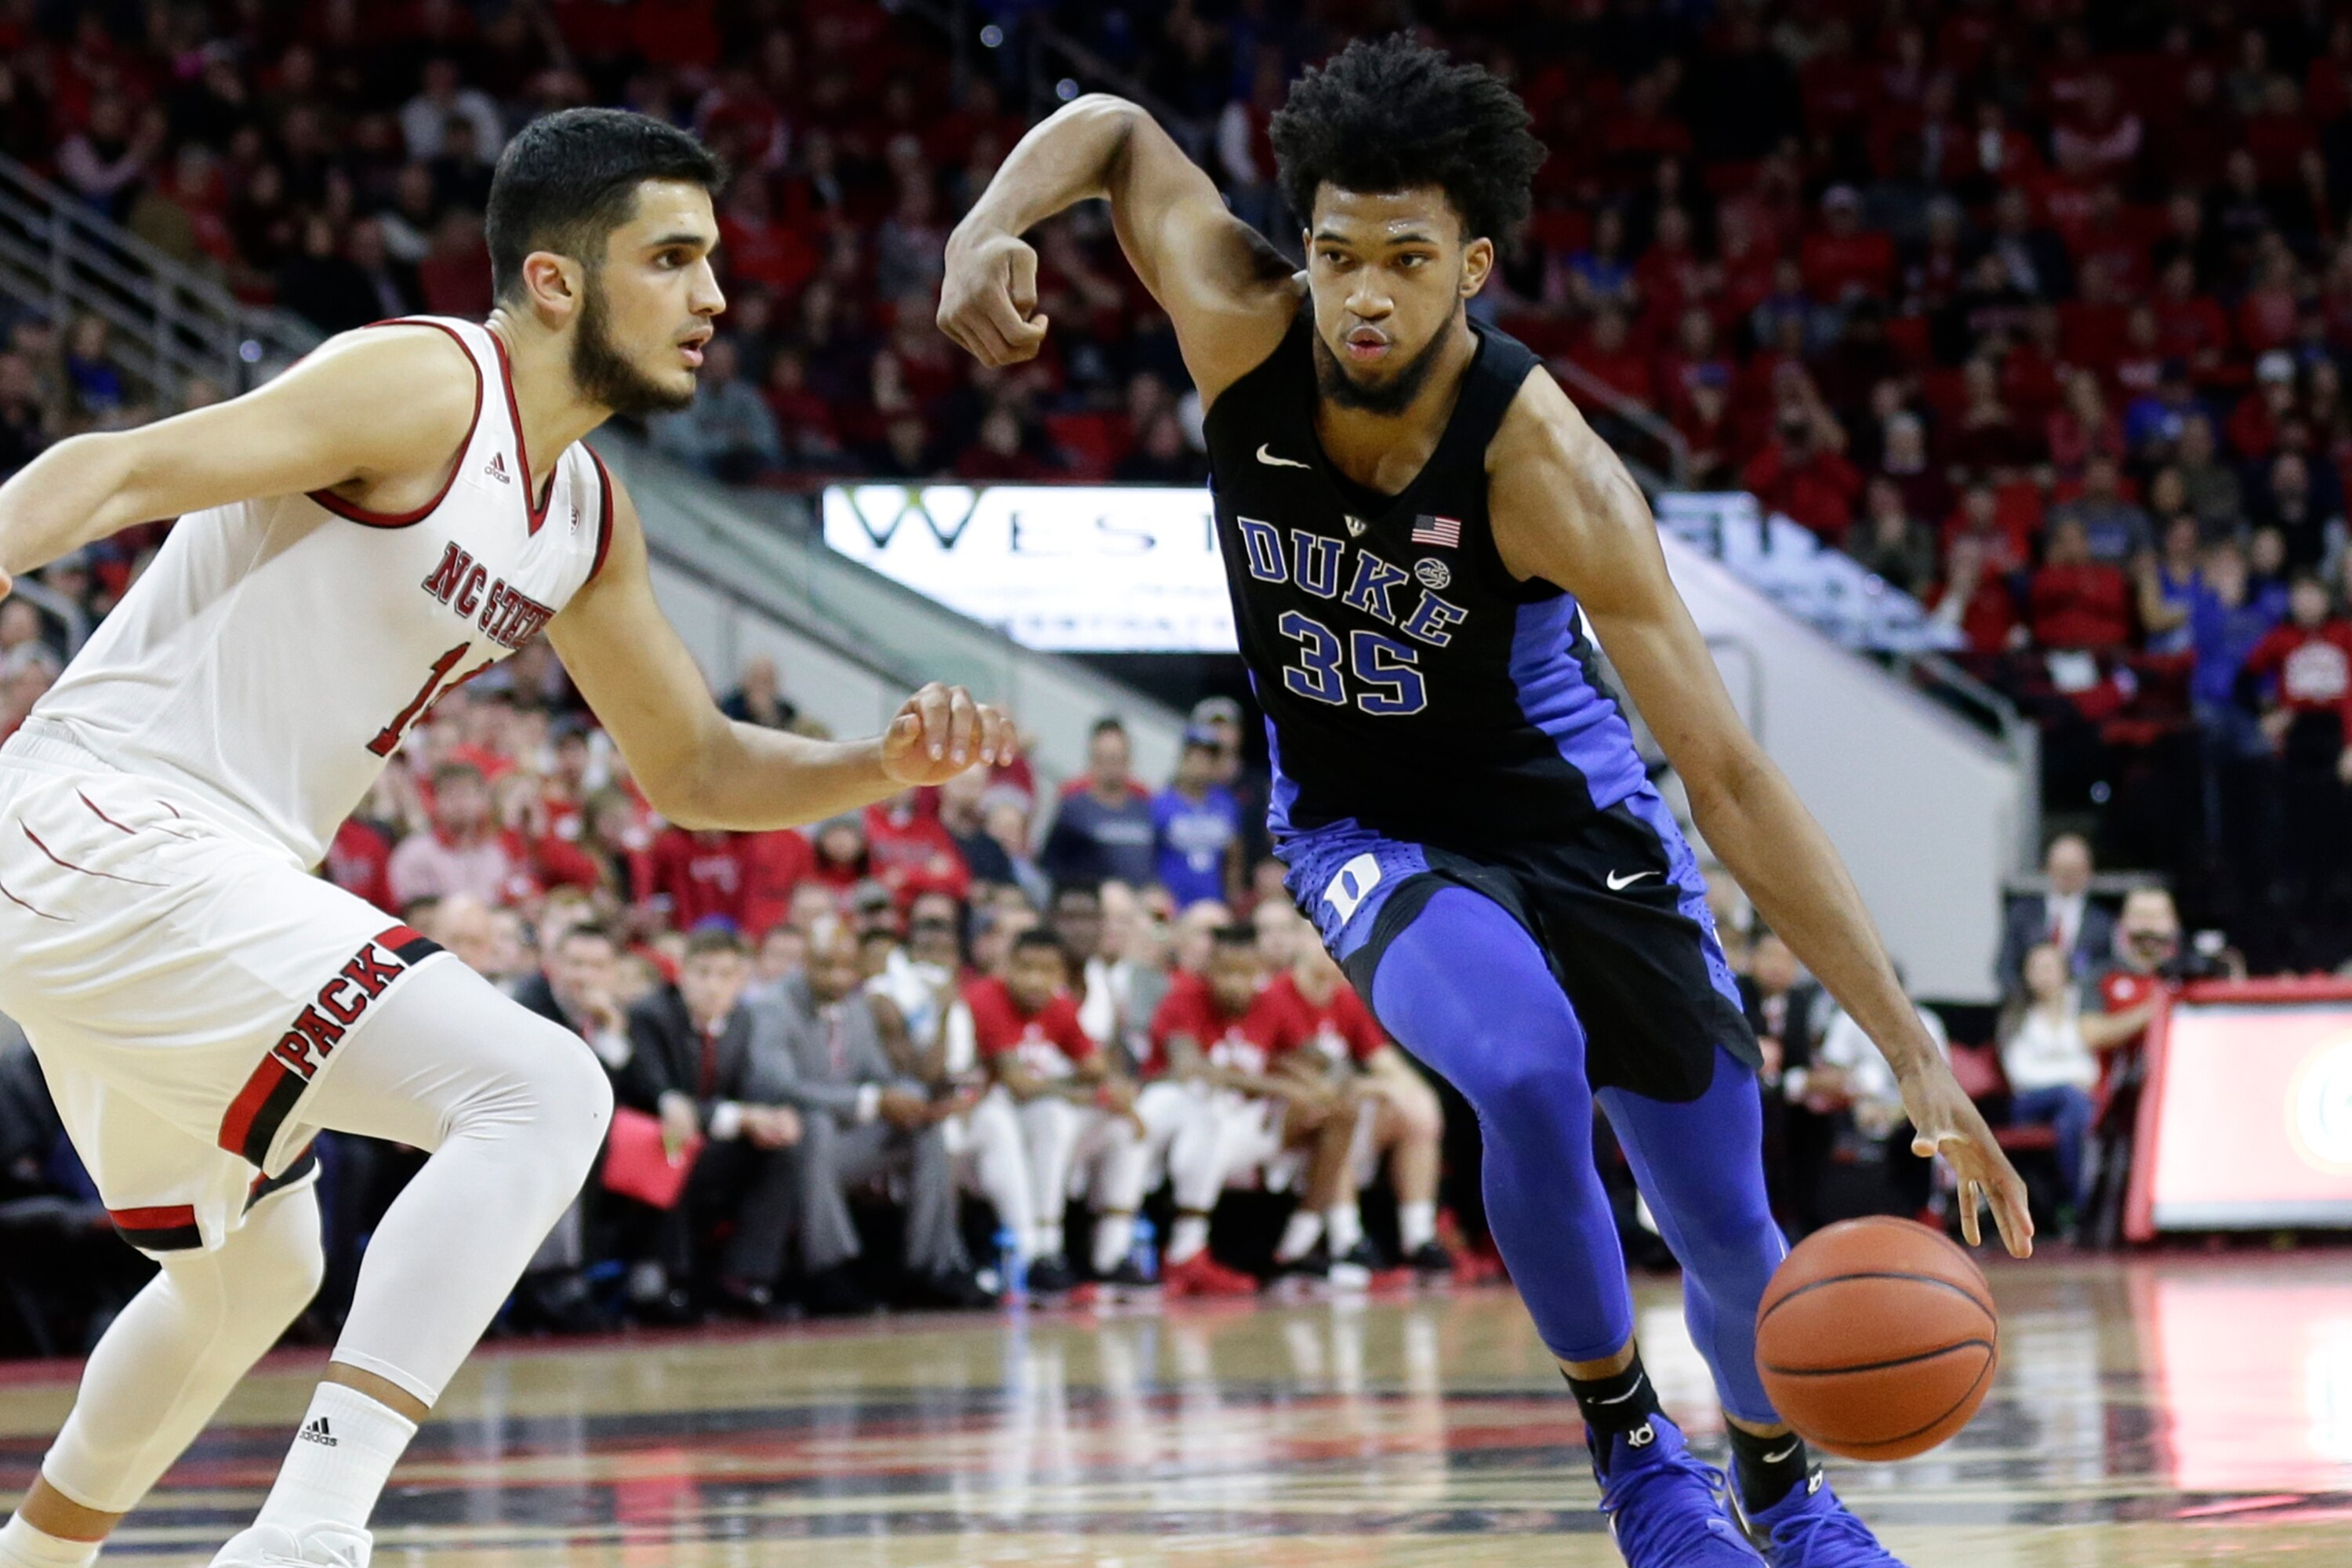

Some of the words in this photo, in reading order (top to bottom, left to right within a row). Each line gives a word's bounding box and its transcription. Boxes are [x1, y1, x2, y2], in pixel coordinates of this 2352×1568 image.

[421, 541, 487, 619] NC
[1237, 516, 1468, 648] DUKE
[365, 641, 495, 758] 1
[1279, 609, 1428, 716] 35
[272, 942, 405, 1080] PACK
[299, 1429, 338, 1447] adidas
